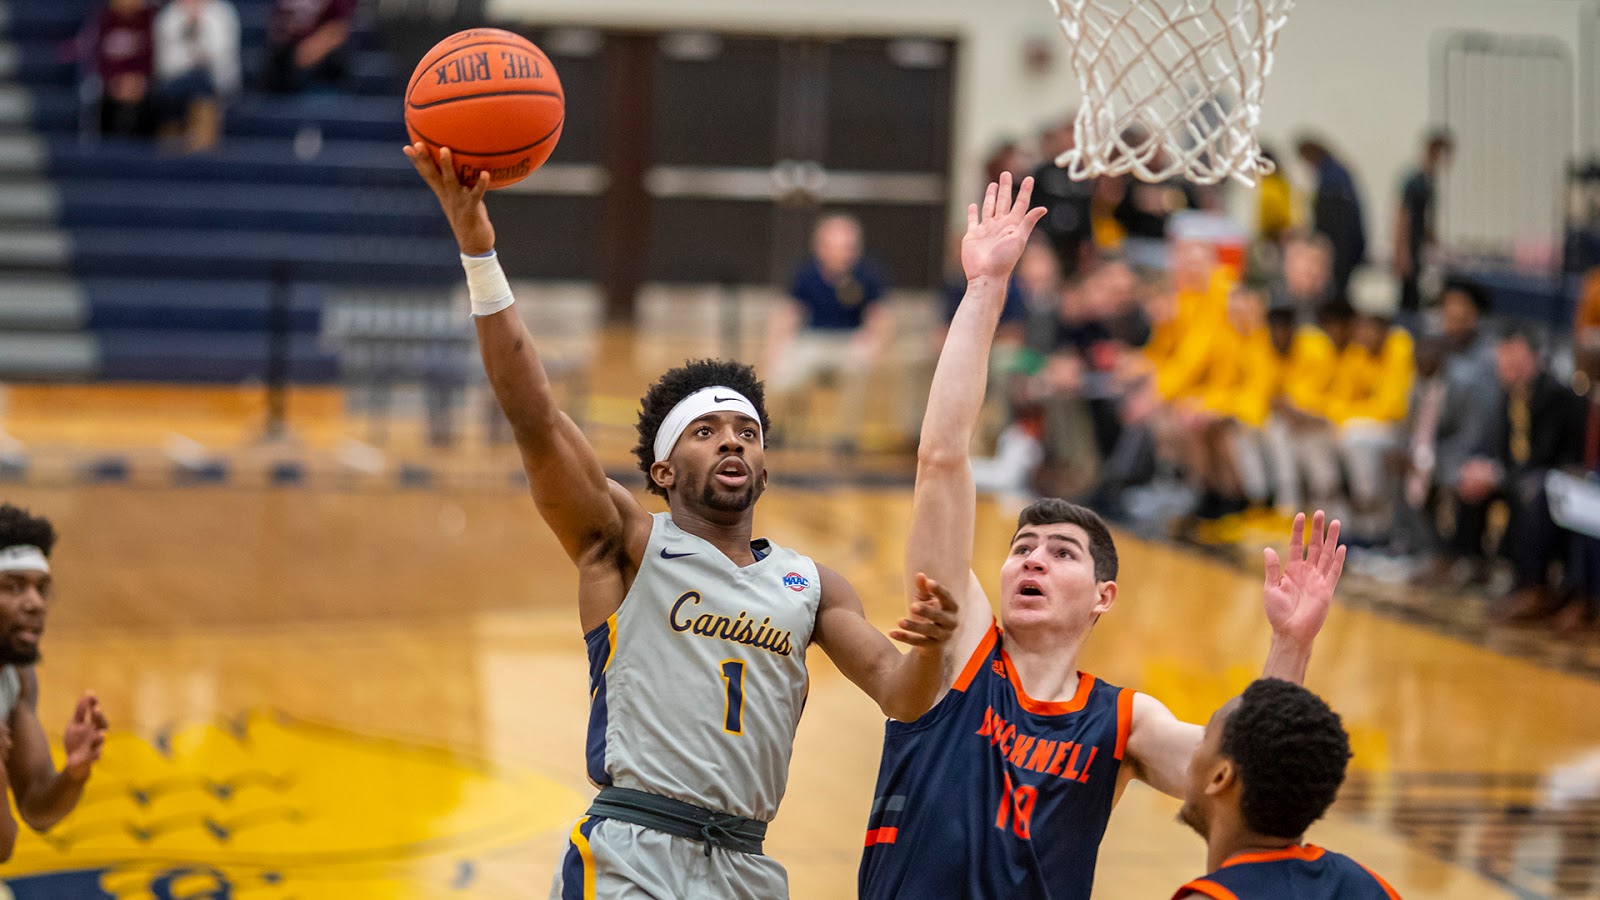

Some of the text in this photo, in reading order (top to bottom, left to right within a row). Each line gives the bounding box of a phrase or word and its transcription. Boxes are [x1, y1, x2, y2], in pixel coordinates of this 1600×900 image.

[435, 52, 543, 85] THE ROCK
[782, 576, 809, 587] MAAC
[669, 590, 793, 657] Canisius
[719, 657, 747, 737] 1
